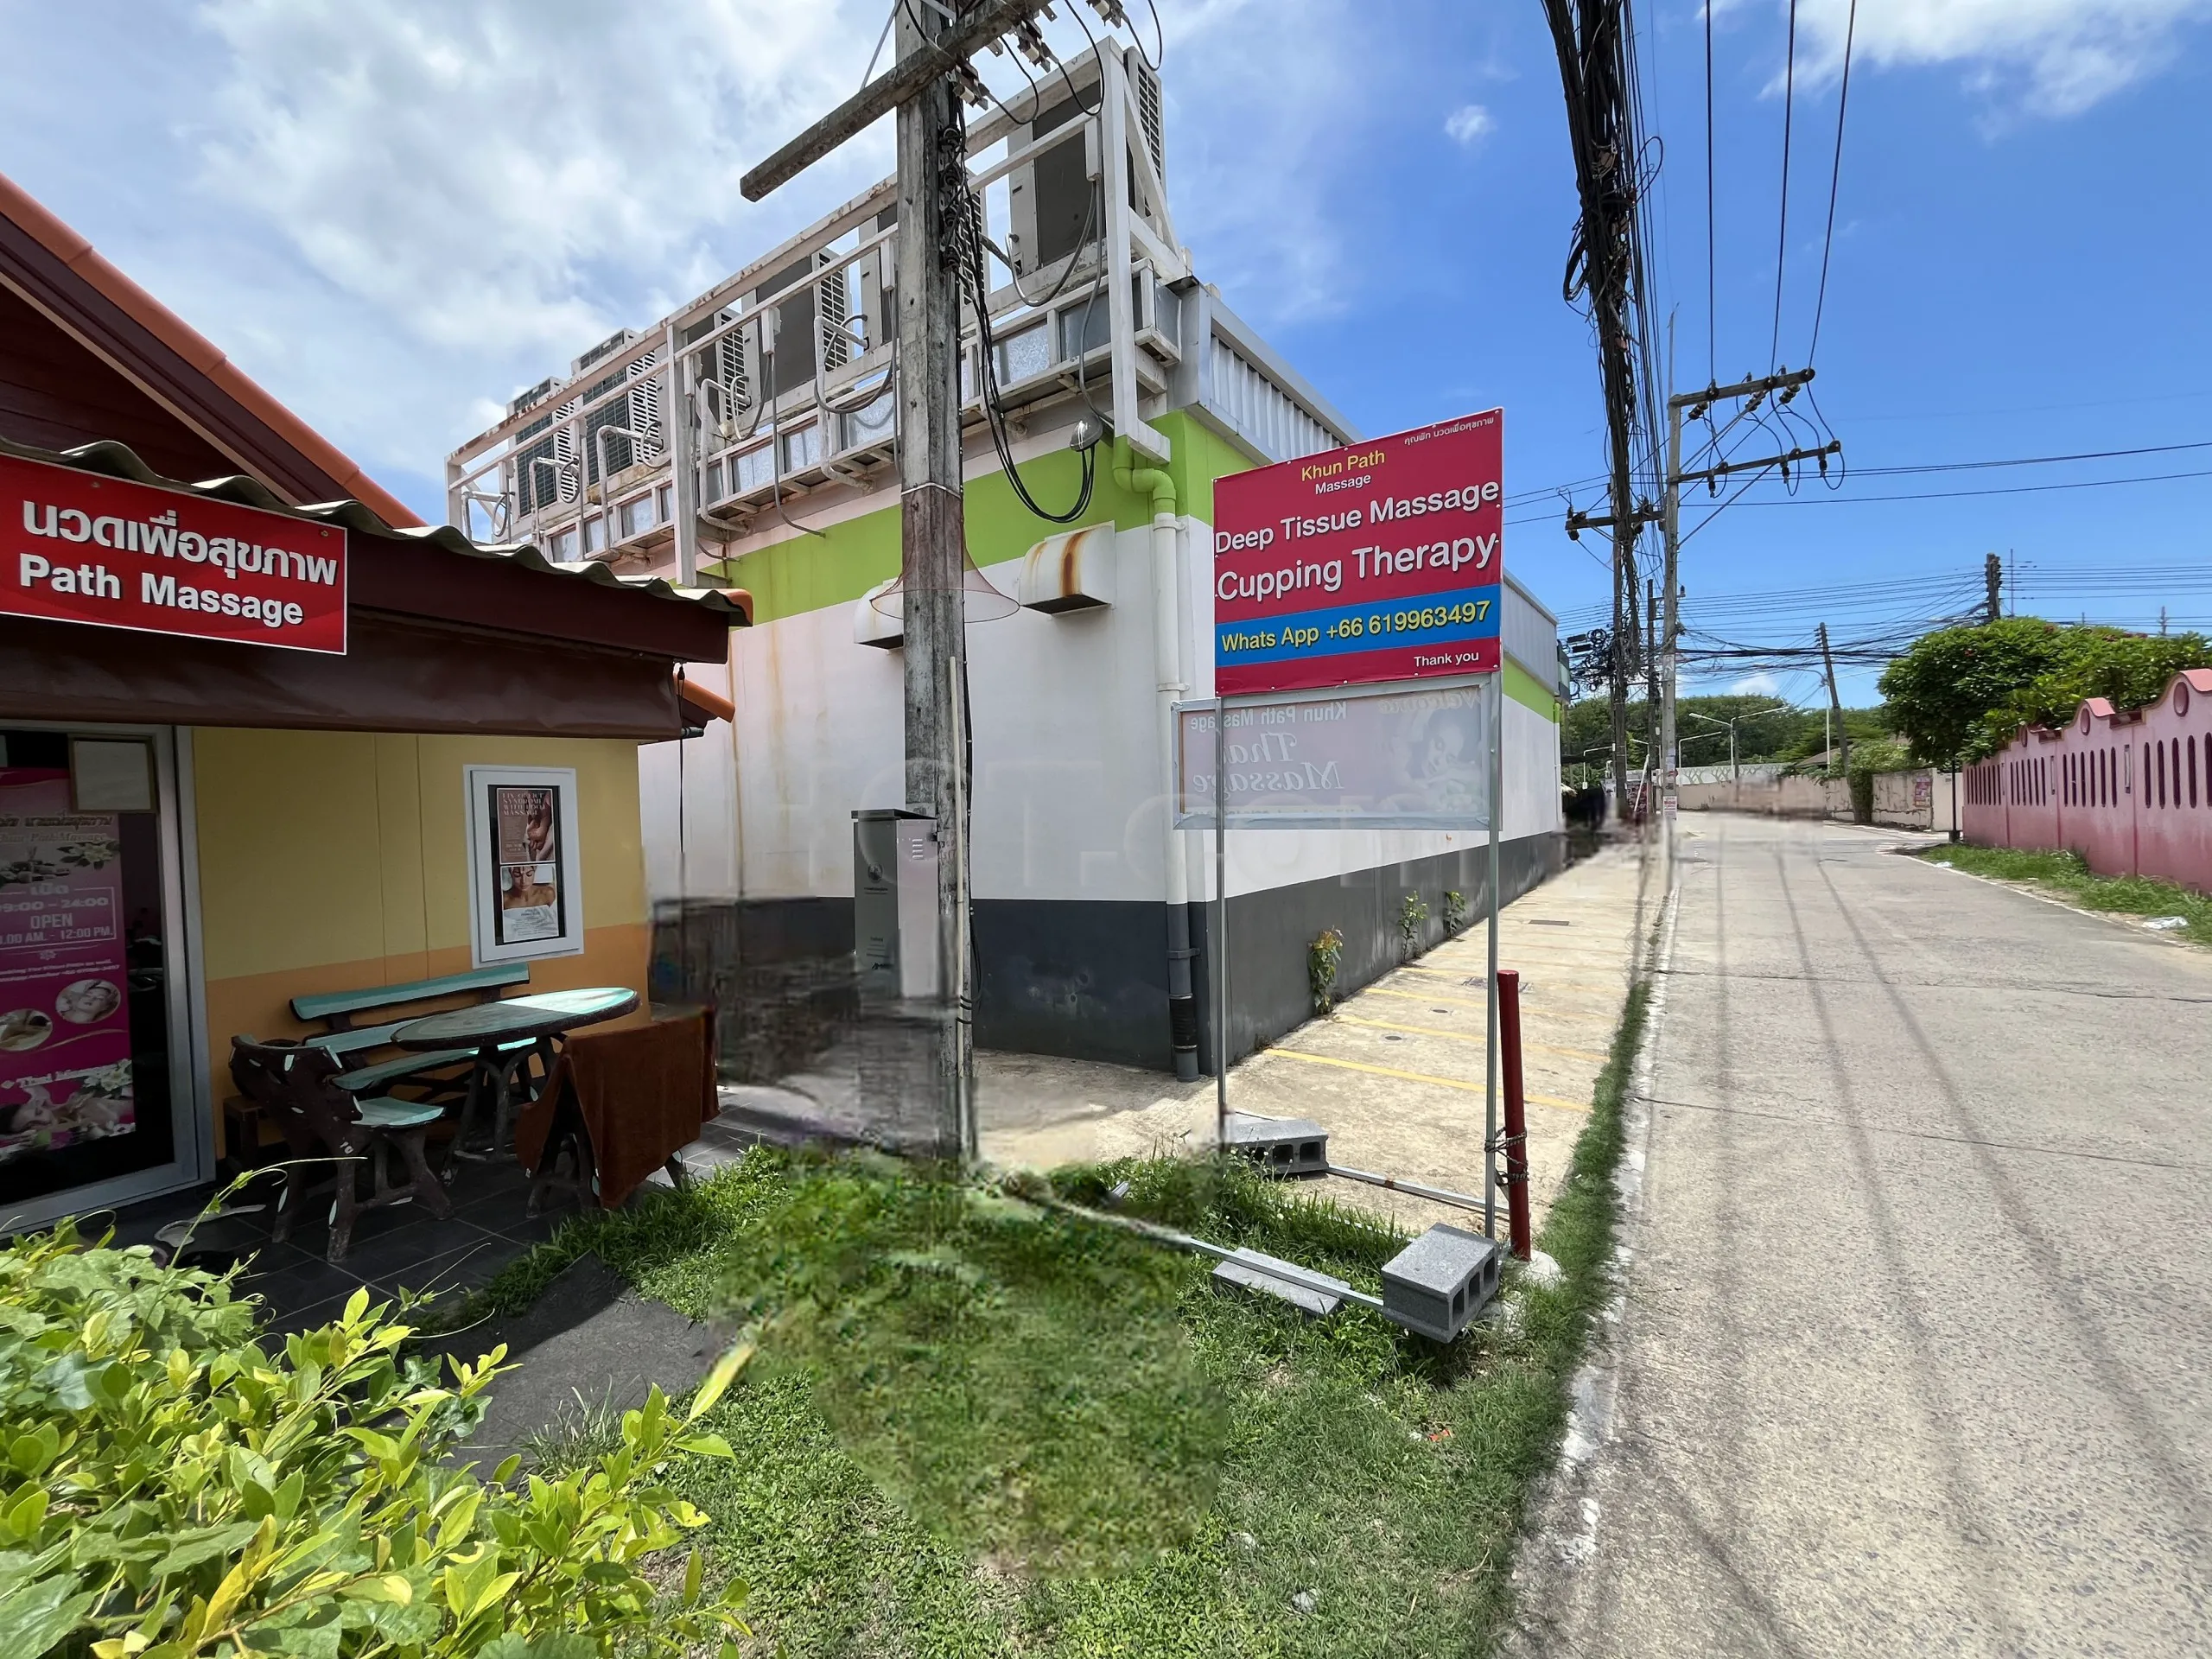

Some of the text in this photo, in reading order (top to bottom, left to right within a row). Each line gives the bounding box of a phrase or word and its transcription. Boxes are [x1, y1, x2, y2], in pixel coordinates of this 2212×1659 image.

[1301, 449, 1385, 481] Khun Path
[1315, 474, 1371, 495] Massage
[1215, 480, 1499, 553] Deep Tissue Massage
[22, 500, 338, 587] นวดเพื่อสุขภาพ
[1217, 531, 1497, 602] Cupping Therapy
[19, 552, 304, 628] Path Massage
[1221, 600, 1491, 652] Whats App +66 619963497
[1414, 652, 1479, 668] Thank you
[0, 900, 45, 913] 9:00
[30, 912, 73, 931] OPEN
[60, 927, 92, 941] 12:00
